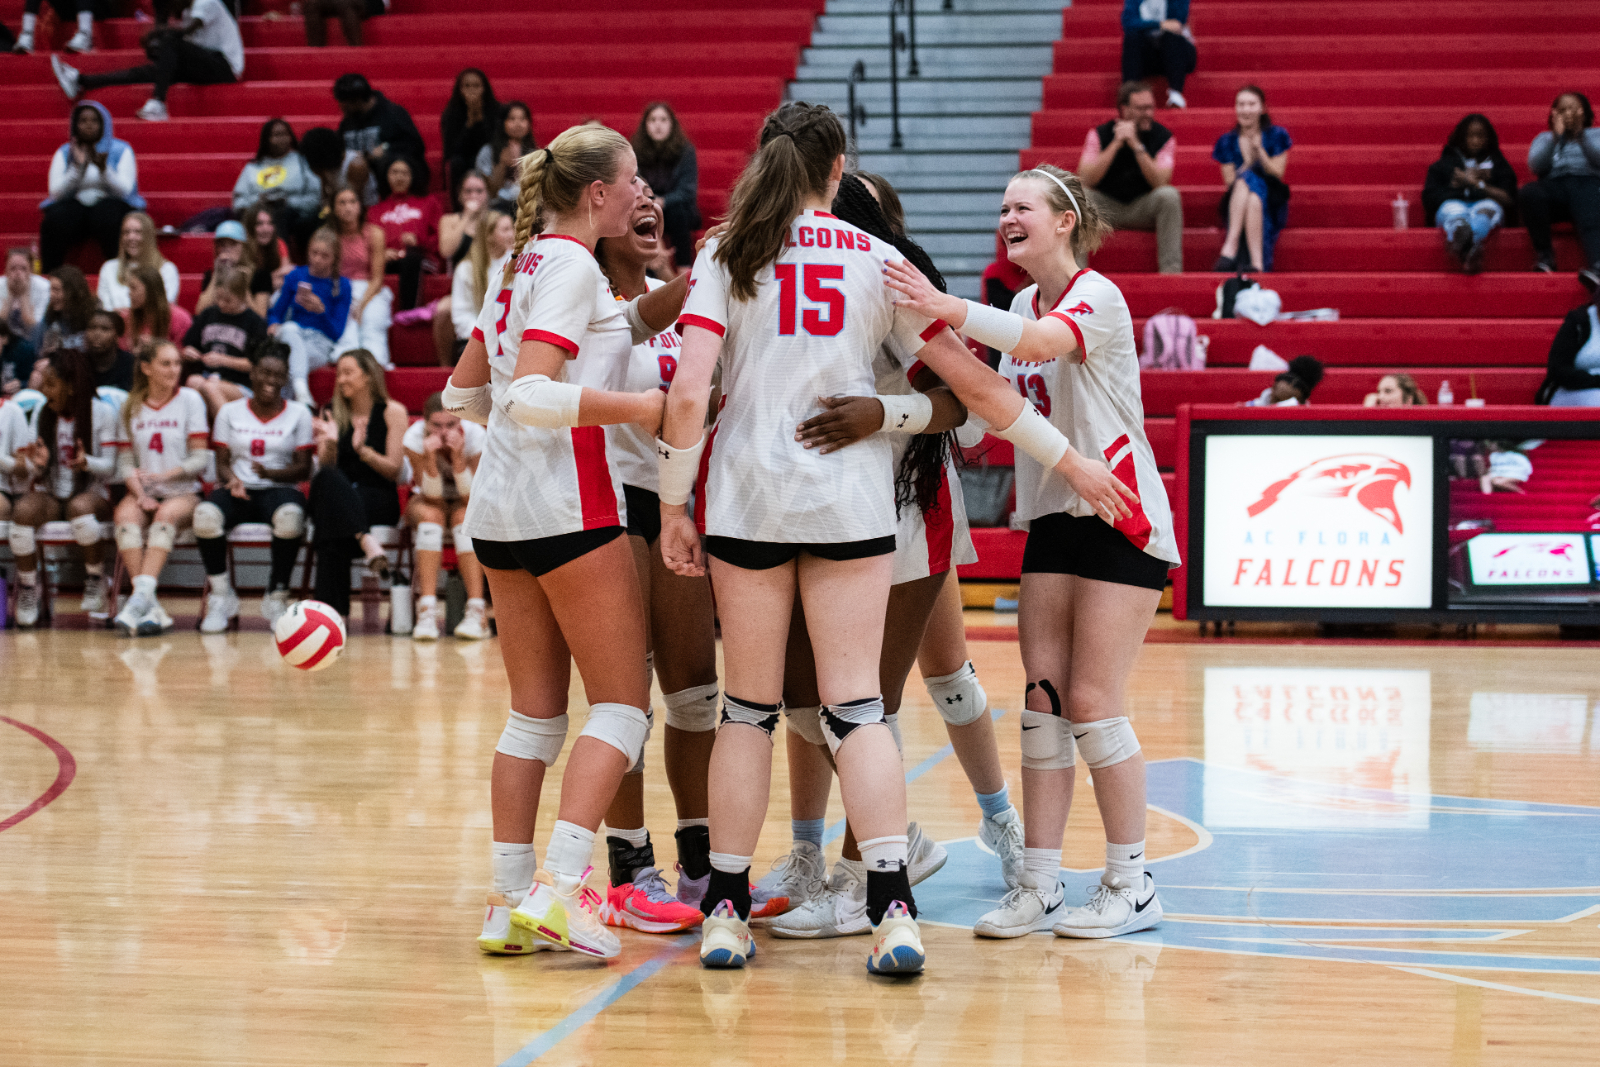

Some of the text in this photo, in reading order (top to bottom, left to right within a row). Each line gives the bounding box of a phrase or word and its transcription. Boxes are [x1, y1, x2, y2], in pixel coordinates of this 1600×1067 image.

[783, 225, 872, 252] LCONS
[774, 262, 847, 338] 15
[1016, 373, 1052, 419] 13
[148, 432, 165, 454] 4
[1244, 530, 1390, 546] AC FLORA
[1232, 557, 1405, 588] FALCONS
[1487, 568, 1575, 579] FALCONS
